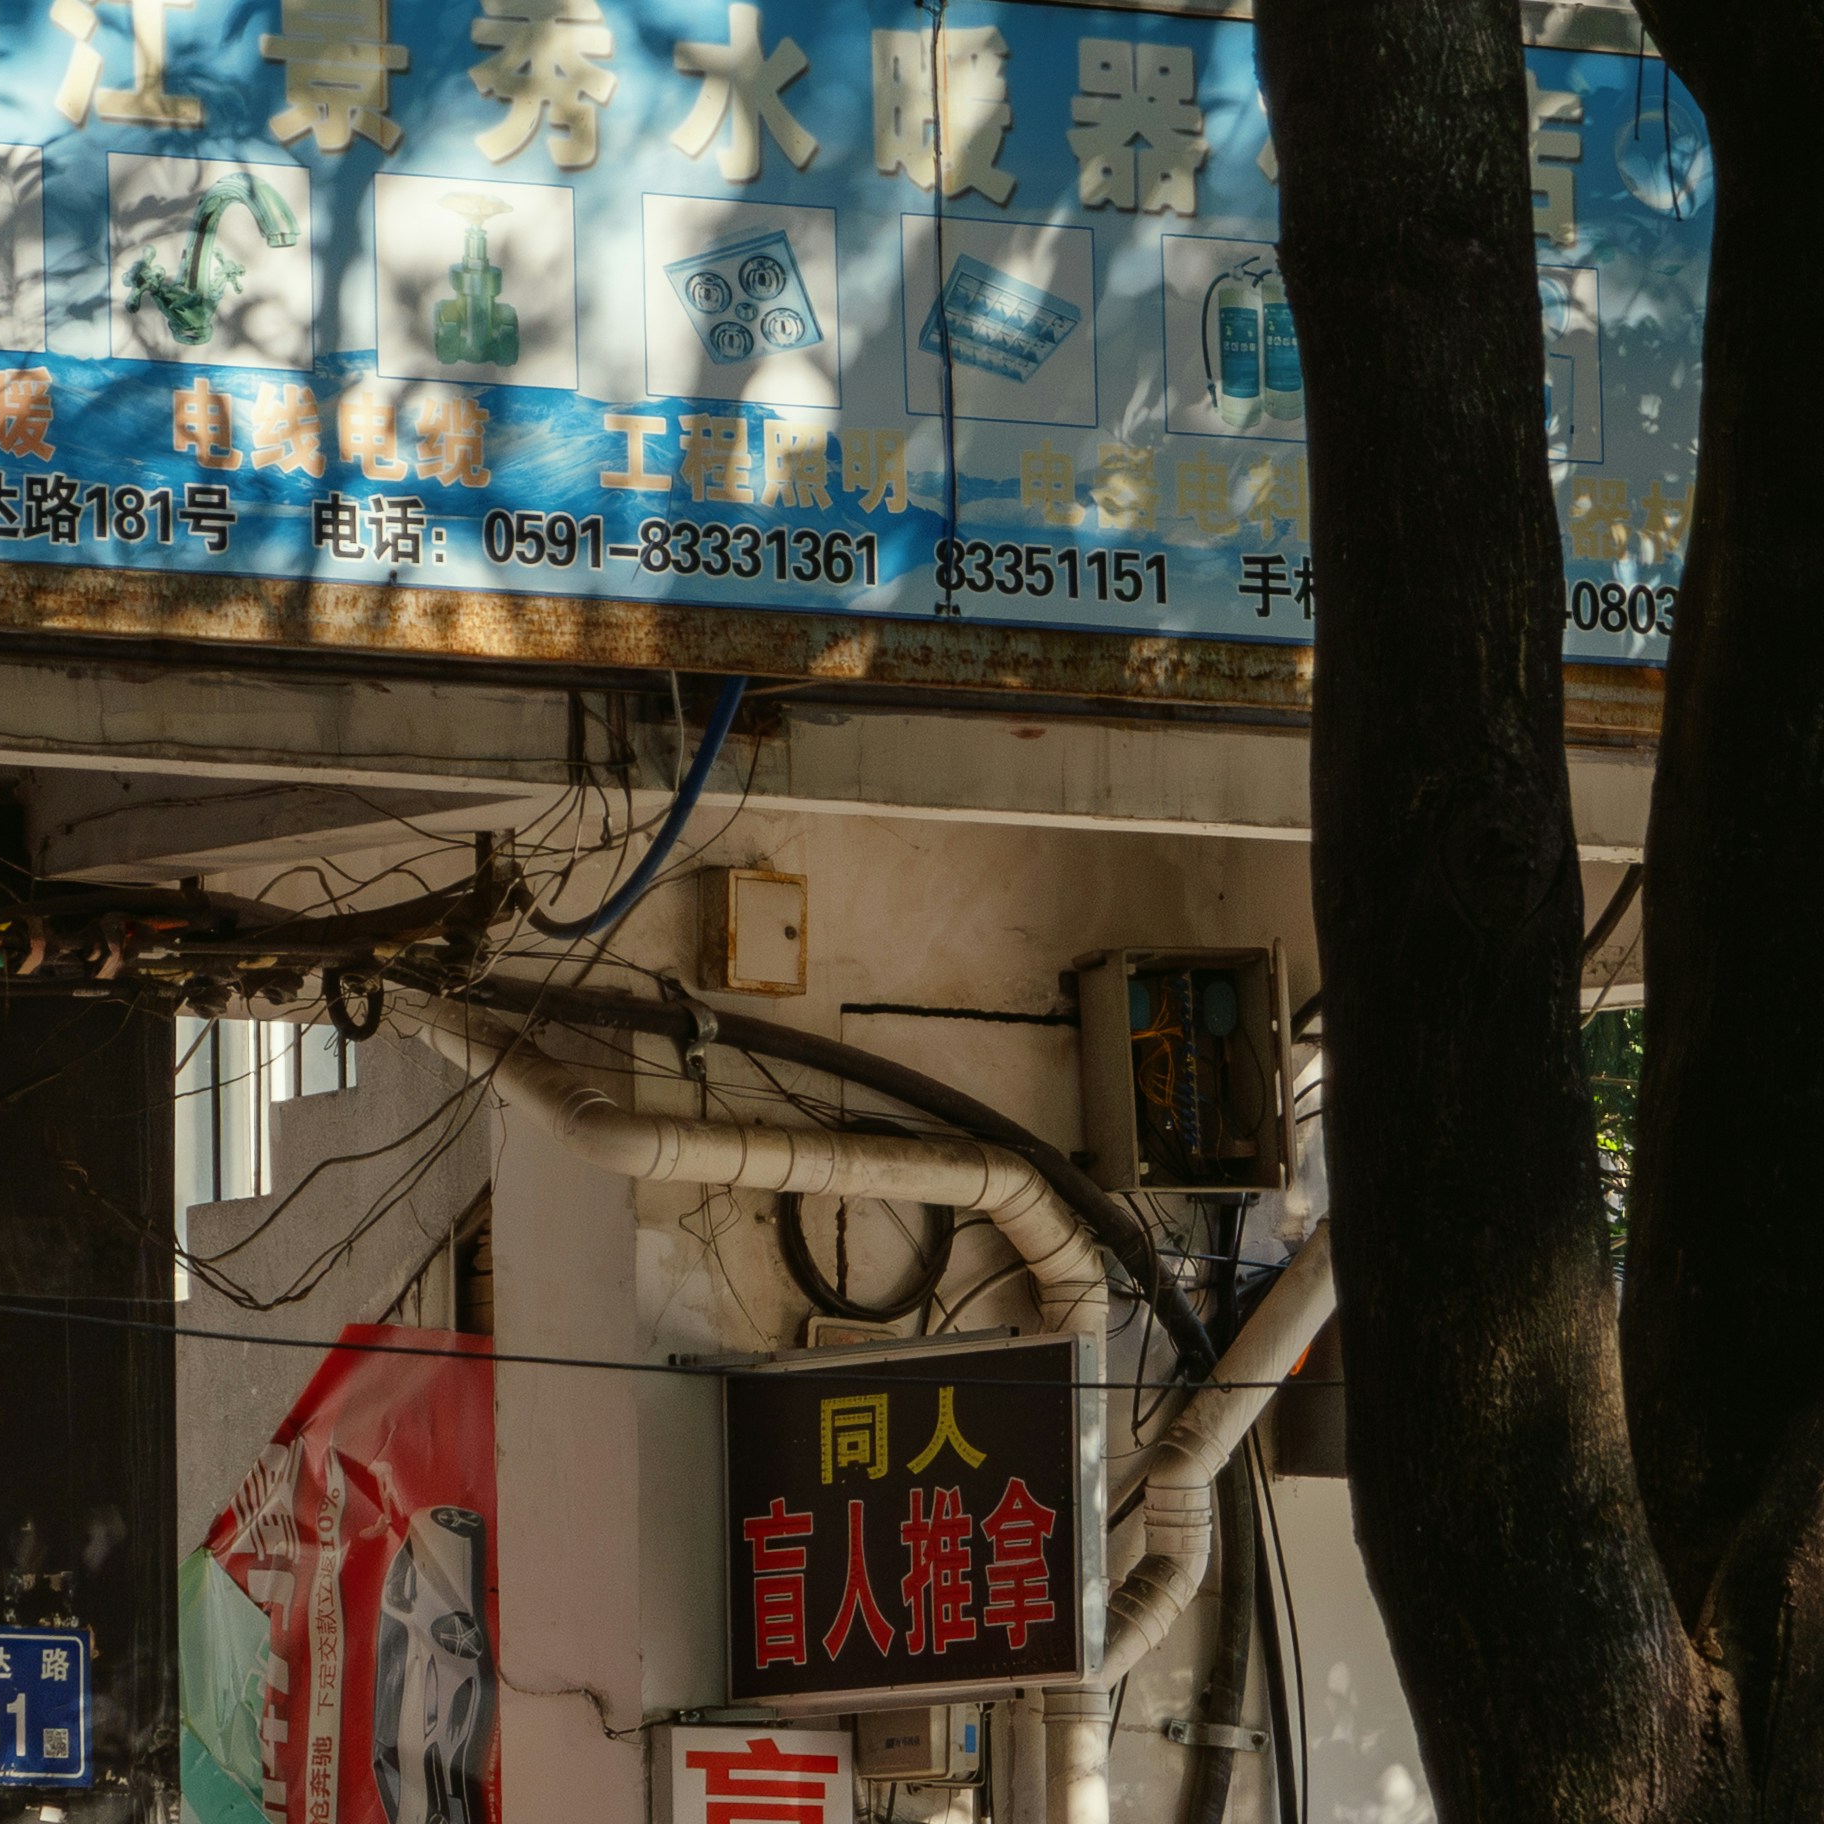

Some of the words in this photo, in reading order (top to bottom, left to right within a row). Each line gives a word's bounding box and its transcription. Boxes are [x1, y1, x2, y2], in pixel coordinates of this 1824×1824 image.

[171, 378, 493, 489] 电线电缆
[600, 412, 910, 515] 工程照明
[482, 508, 879, 589] 0591-83331361
[934, 539, 1169, 607] 83351151
[1563, 580, 1678, 637] 0803
[820, 1385, 987, 1485] 同人
[743, 1477, 1057, 1669] 盲人推拿
